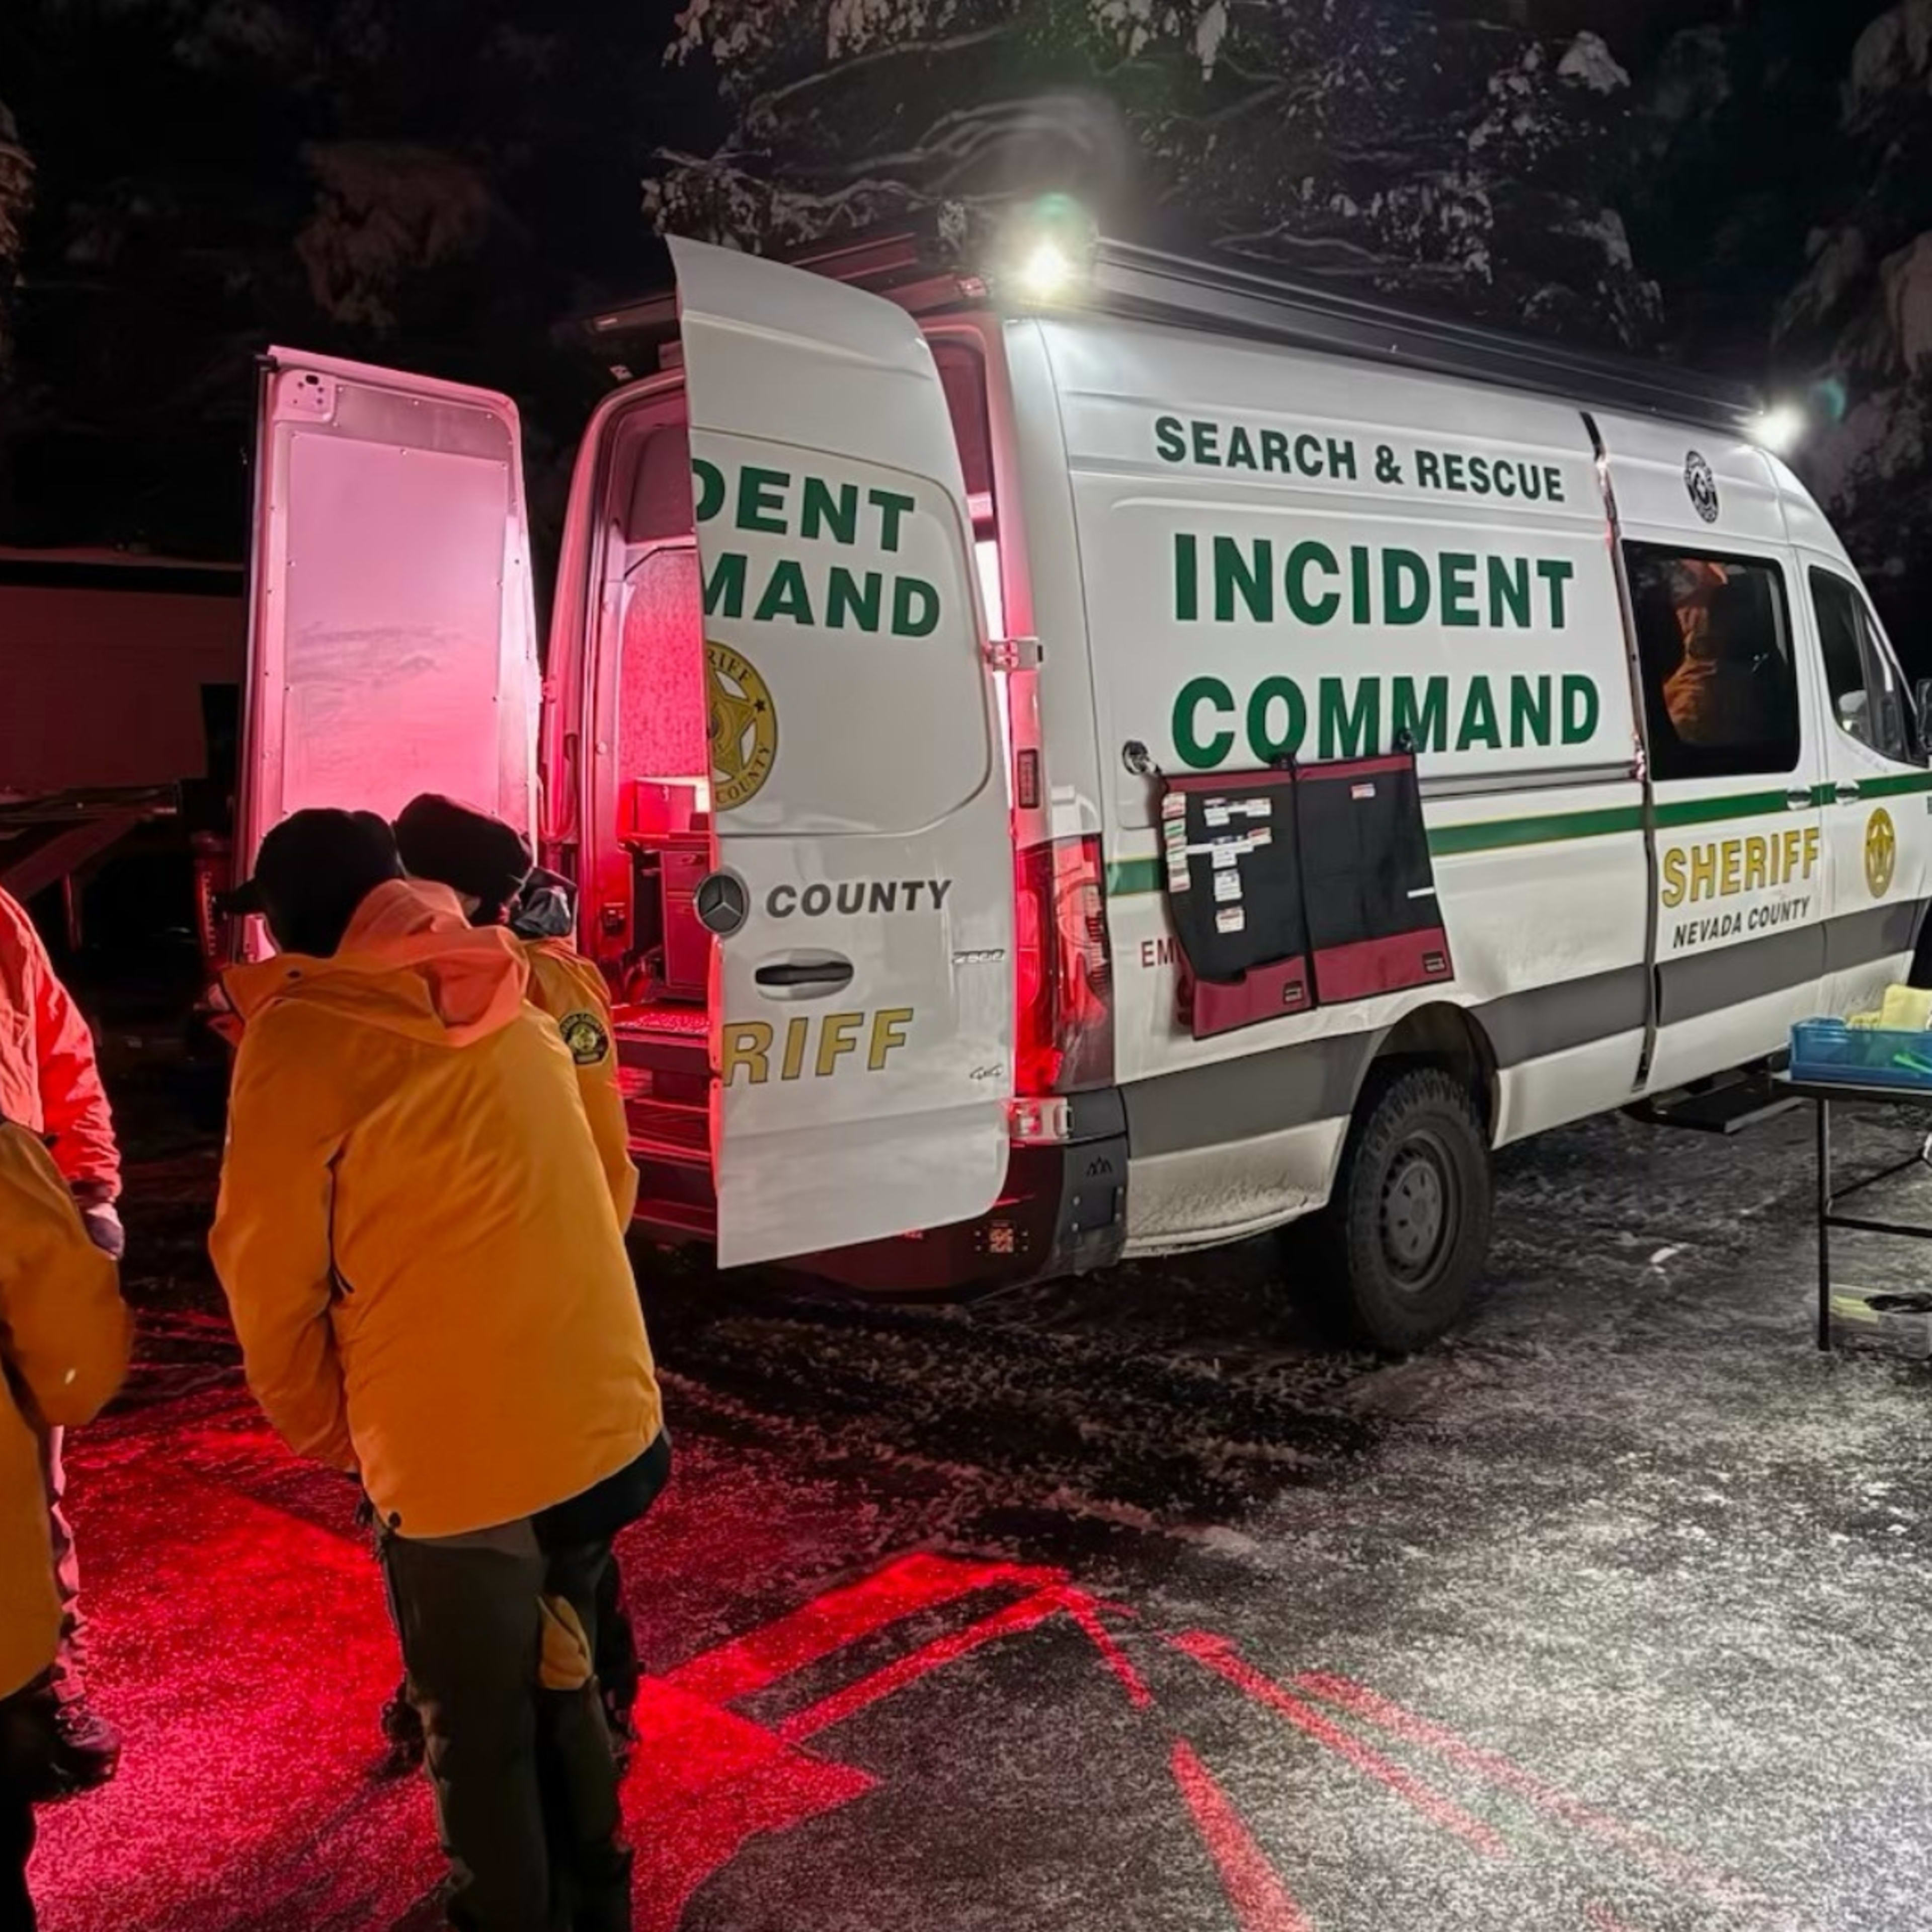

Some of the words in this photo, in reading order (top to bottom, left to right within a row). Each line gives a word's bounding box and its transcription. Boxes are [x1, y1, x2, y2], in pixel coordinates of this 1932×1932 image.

[1155, 417, 1357, 480] SEARCH
[1375, 444, 1404, 485] &
[1415, 450, 1565, 503] RESCUE
[1174, 533, 1574, 629] INCIDENT
[1172, 675, 1600, 770] COMMAND
[766, 879, 952, 918] COUNTY
[1661, 827, 1820, 908] SHERIFF
[1673, 914, 1742, 949] NEVADA
[1748, 896, 1811, 931] COUNTY
[722, 1008, 914, 1087] RIFF
